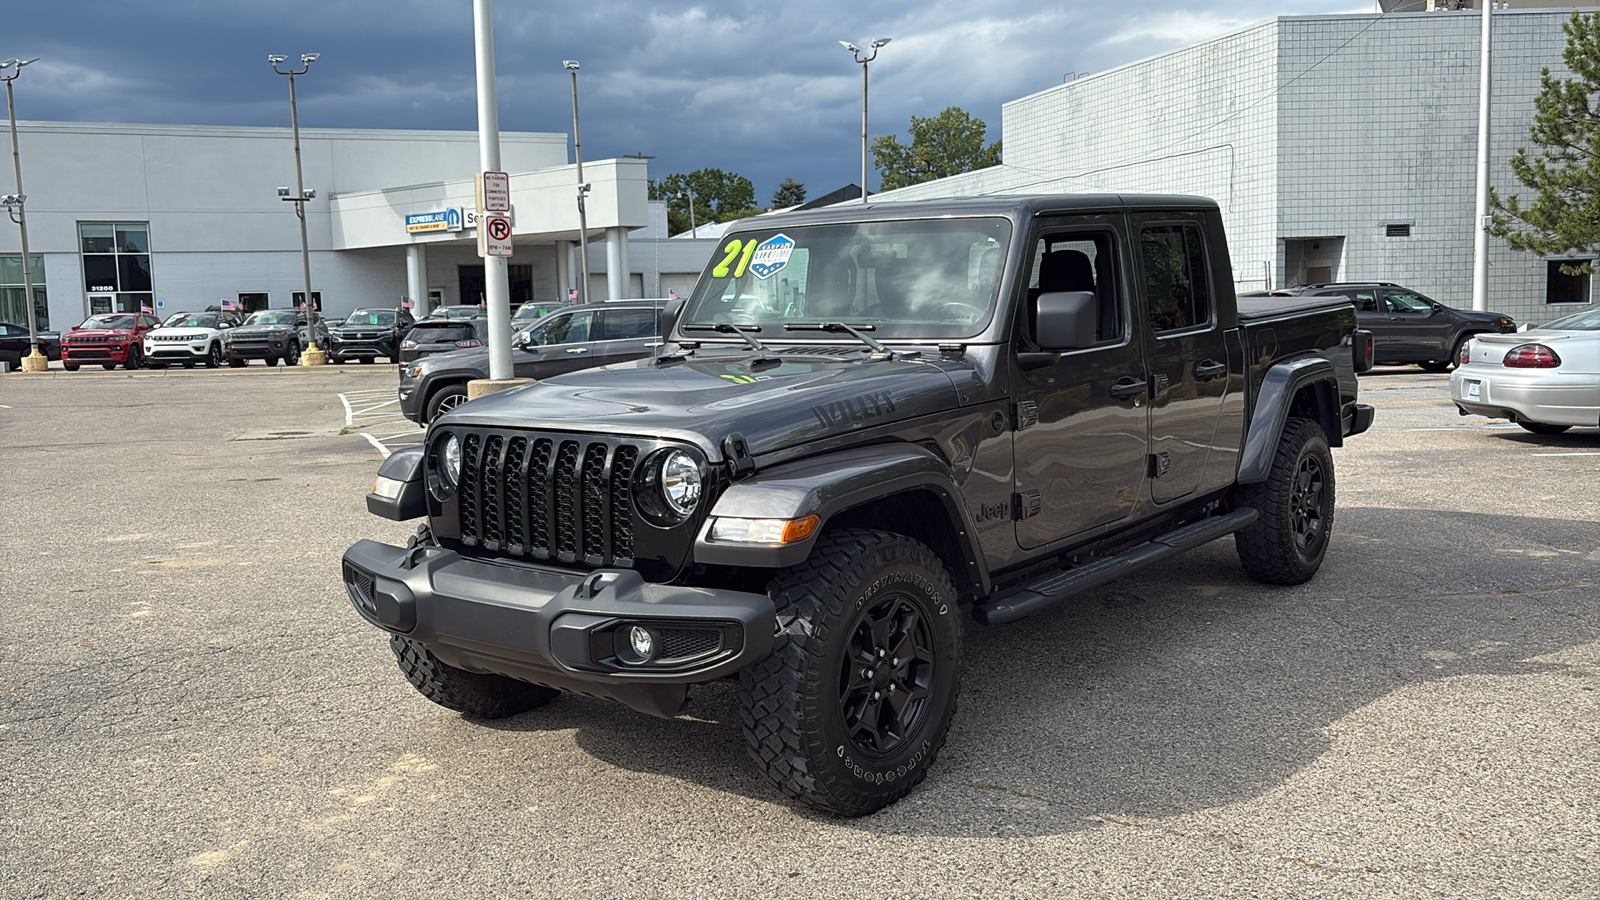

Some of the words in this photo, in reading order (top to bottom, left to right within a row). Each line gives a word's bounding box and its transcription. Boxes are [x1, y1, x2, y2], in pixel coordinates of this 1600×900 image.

[713, 239, 758, 278] 21
[755, 249, 791, 260] LIFETIME
[809, 390, 896, 428] WILLYS
[976, 501, 1008, 522] Jeep
[856, 572, 942, 610] DESTINATION
